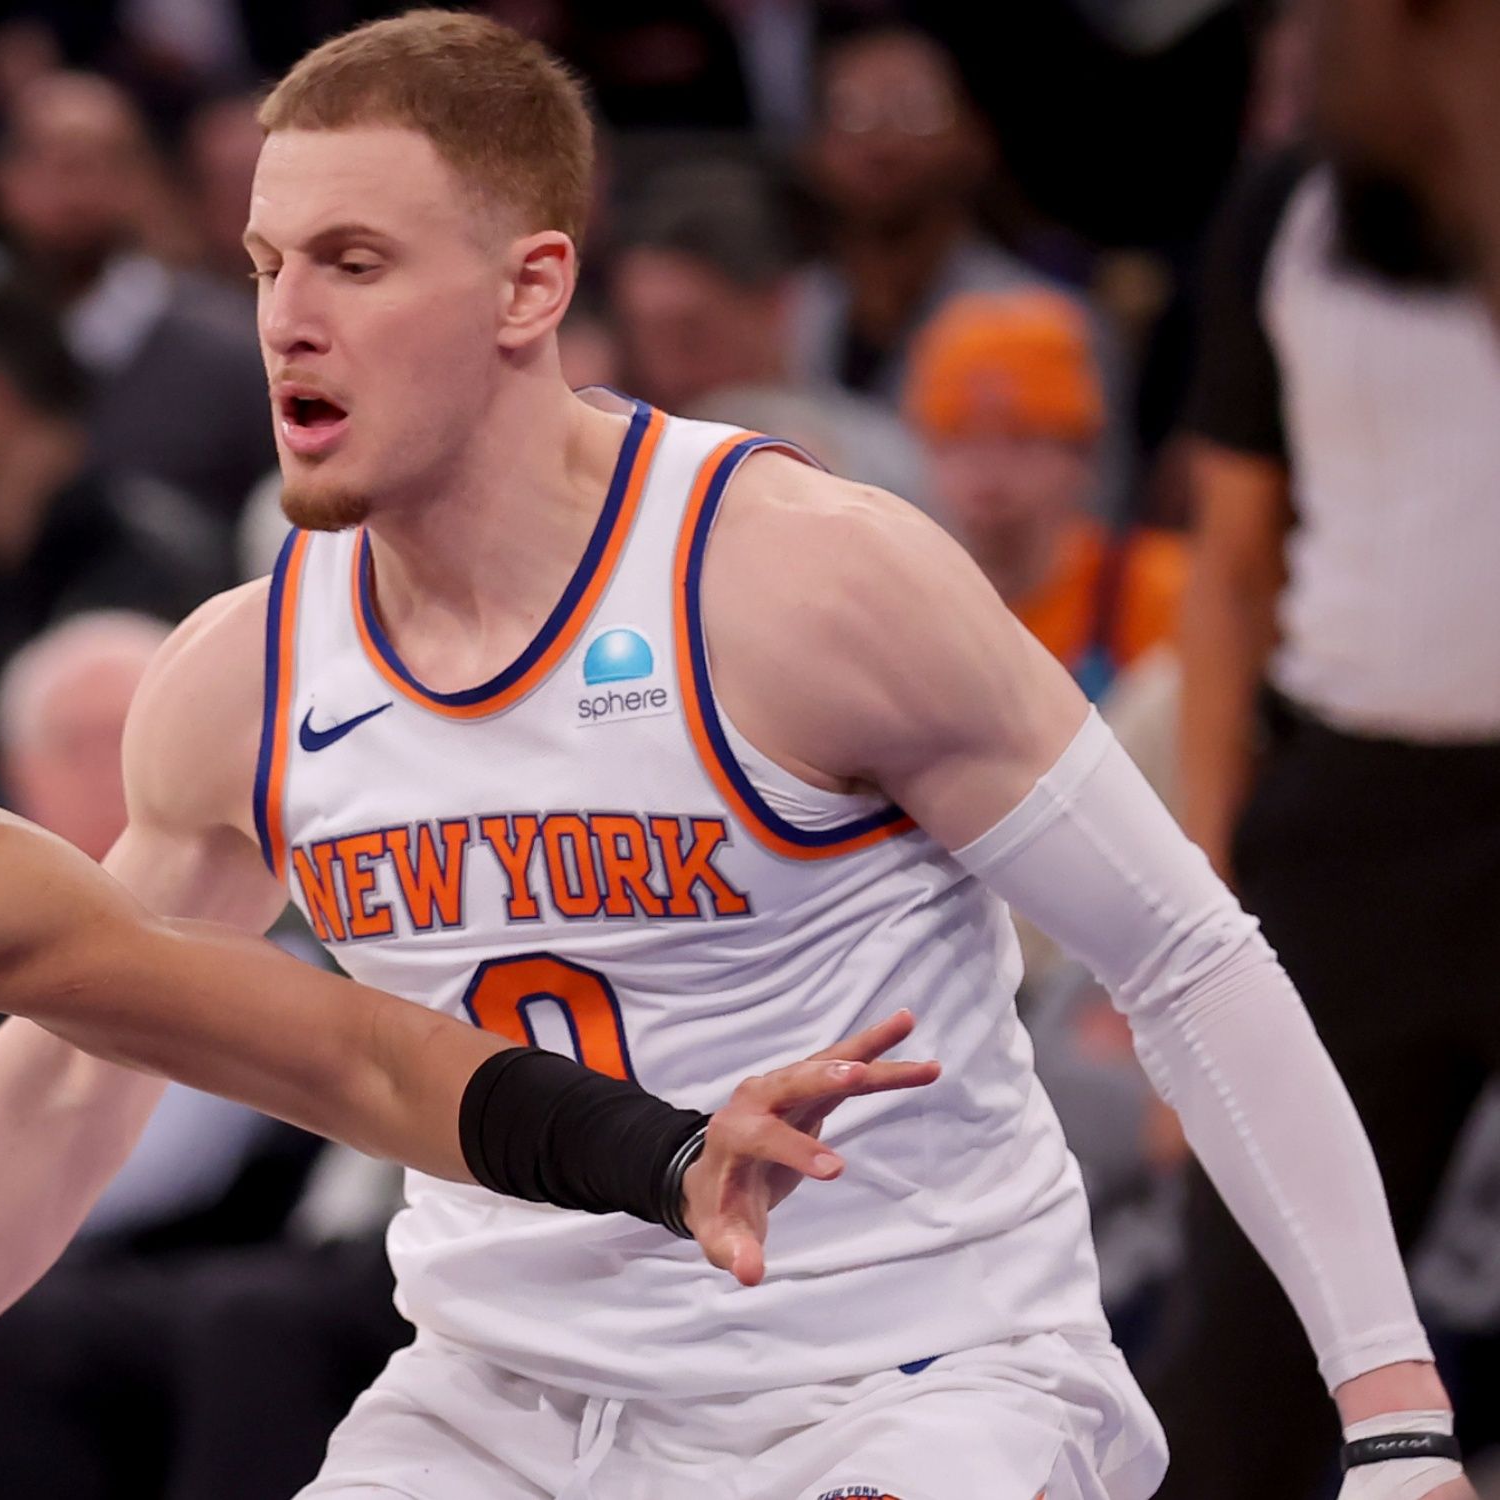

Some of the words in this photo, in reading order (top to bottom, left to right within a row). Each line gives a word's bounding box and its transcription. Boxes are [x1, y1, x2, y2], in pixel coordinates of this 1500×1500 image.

[577, 687, 668, 721] sphere
[290, 812, 471, 944] NEW
[477, 811, 751, 923] YORK
